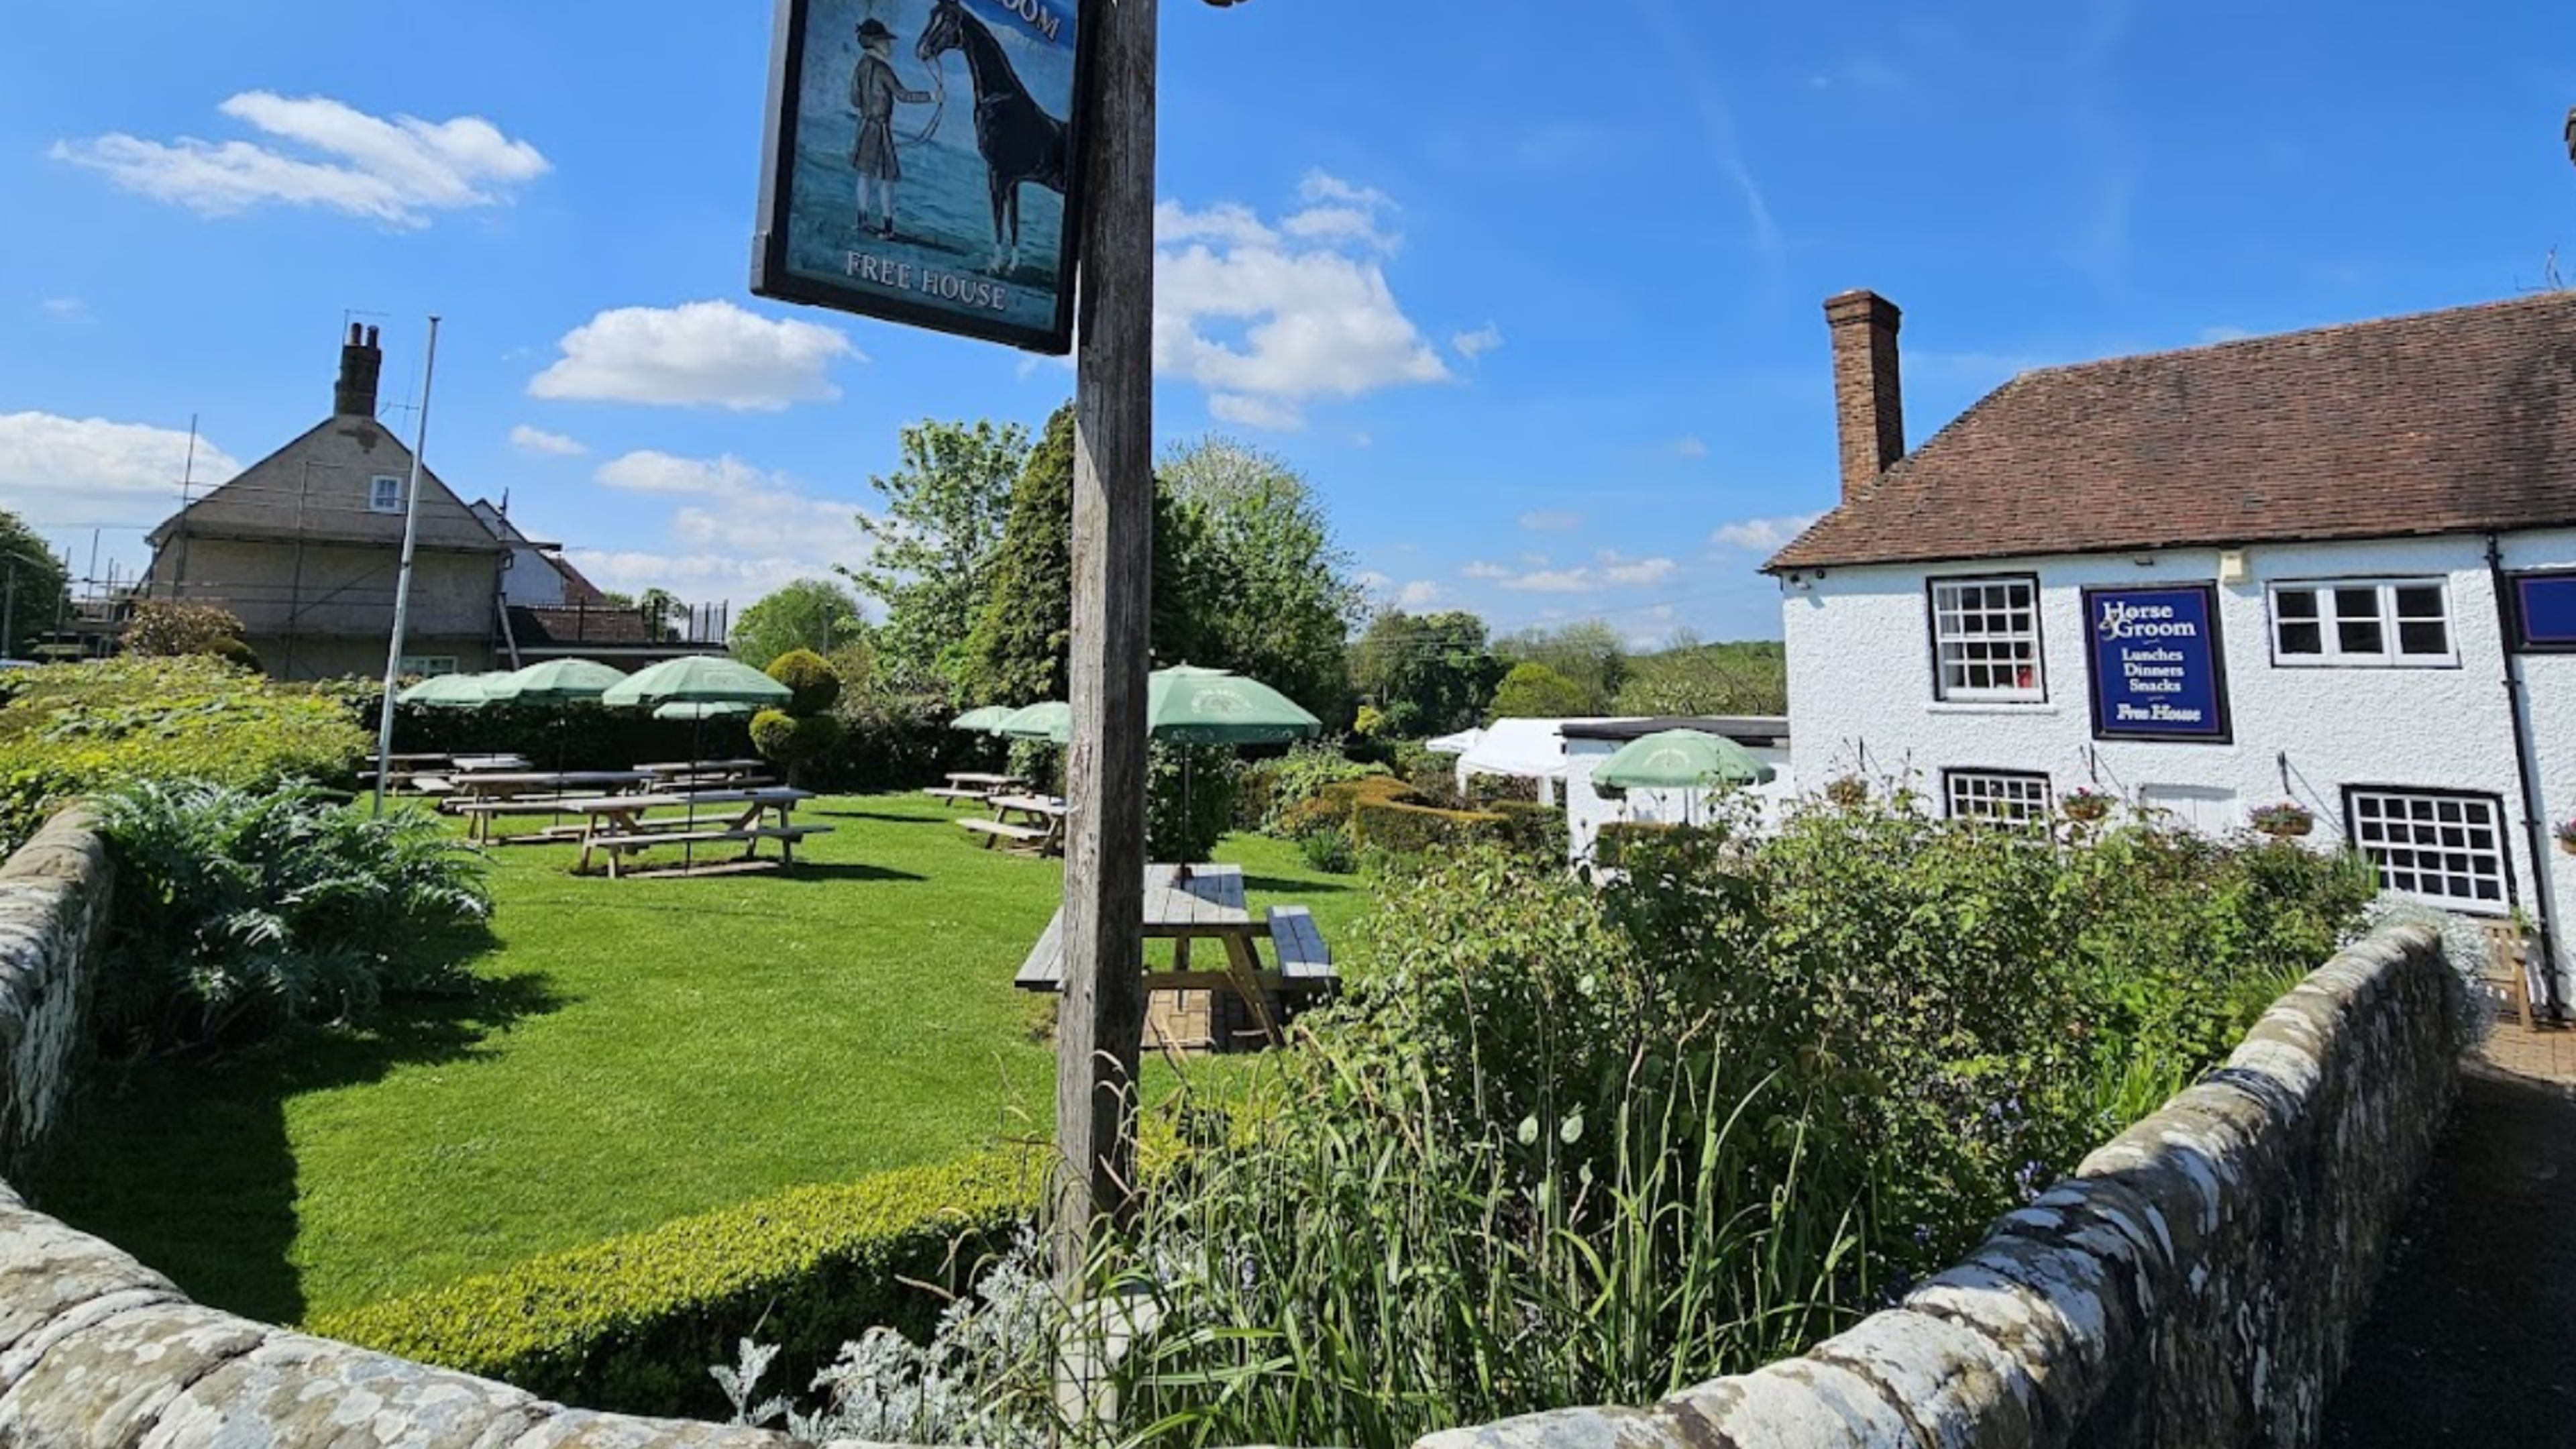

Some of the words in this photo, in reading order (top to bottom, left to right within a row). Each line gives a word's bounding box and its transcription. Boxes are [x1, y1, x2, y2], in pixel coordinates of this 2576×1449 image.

[846, 250, 912, 289] FREE
[921, 270, 1006, 310] HOUSE
[2102, 602, 2173, 619] Horse
[2116, 619, 2196, 637] Groom
[2121, 647, 2184, 661] Lunches
[2123, 663, 2185, 677] Dinners
[2129, 679, 2181, 692] Snacks
